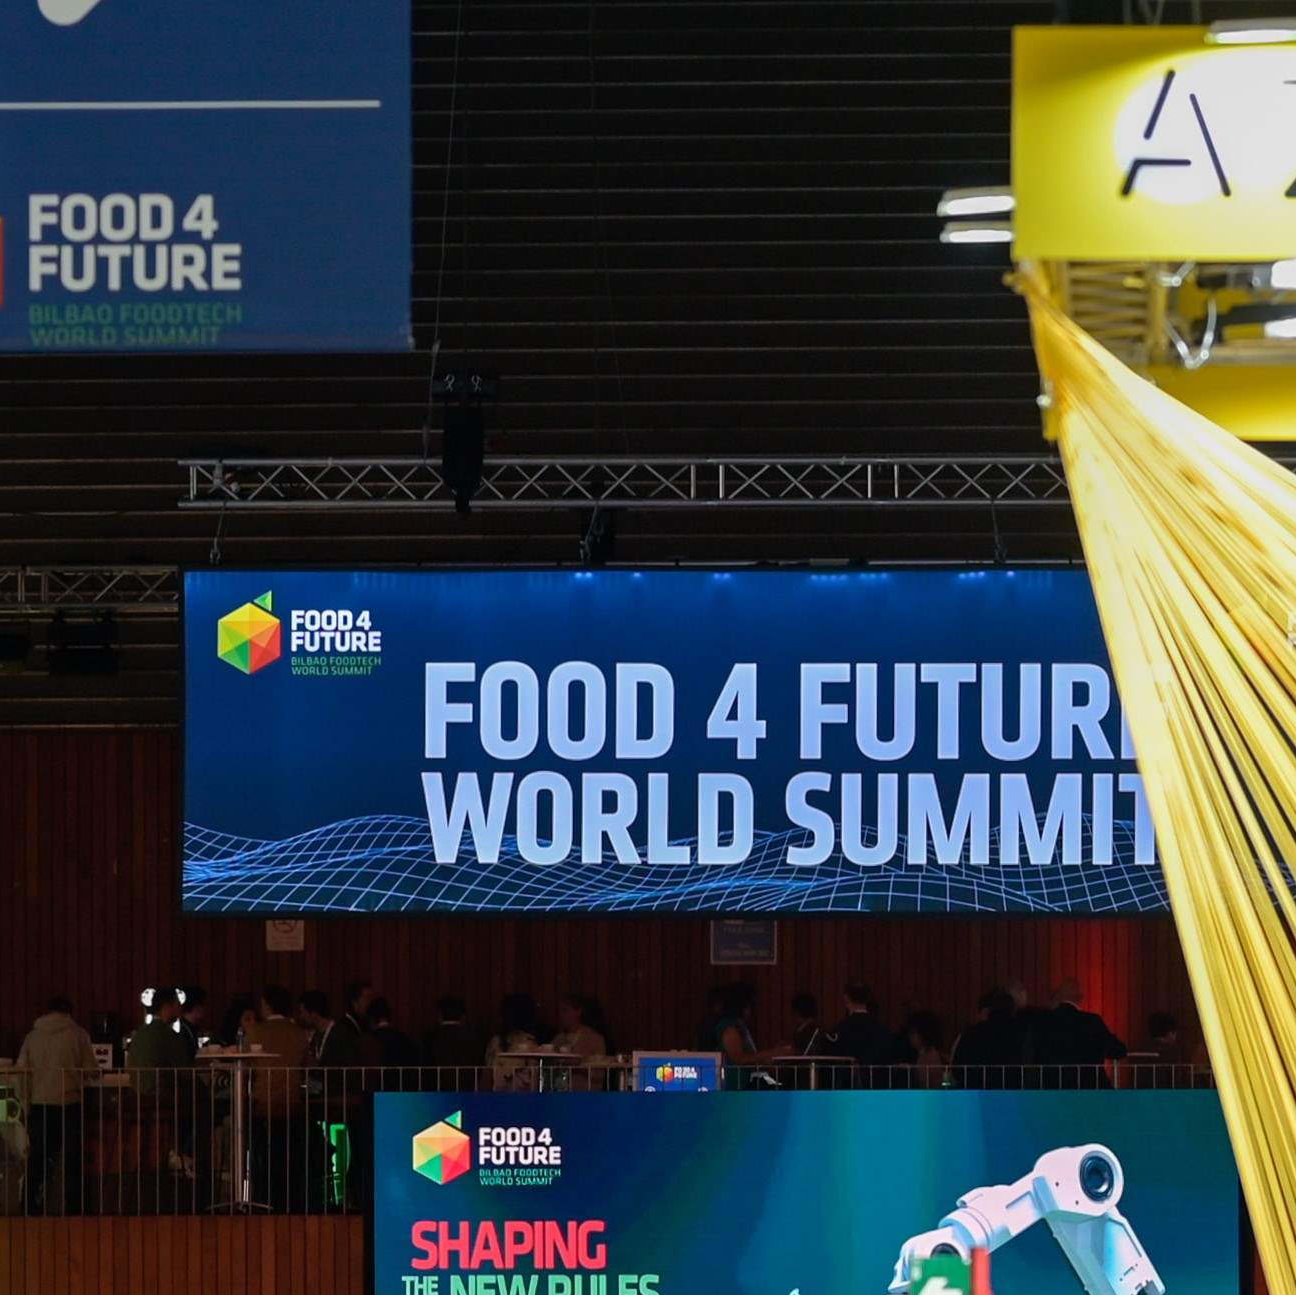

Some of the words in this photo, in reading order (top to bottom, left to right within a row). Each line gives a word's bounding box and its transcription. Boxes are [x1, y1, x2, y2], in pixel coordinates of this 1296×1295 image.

[28, 193, 175, 242] FOOD
[182, 194, 220, 241] 4
[28, 243, 243, 292] FUTURE
[30, 303, 113, 325] BILBAO
[120, 302, 244, 325] FOODTECH
[30, 326, 117, 347] WORLD
[122, 325, 221, 346] SUMMIT
[290, 610, 353, 631] FOOD
[355, 610, 372, 630] 4
[290, 631, 382, 652] FUTURE
[291, 656, 327, 666] BILBAO
[330, 656, 382, 666] FOODTECH
[291, 666, 328, 676] WORLD
[330, 666, 373, 676] SUMMIT
[424, 660, 674, 762] FOOD
[706, 662, 767, 760] 4
[421, 771, 755, 866] WORLD
[785, 771, 1156, 867] SUMMIT
[478, 1127, 536, 1146] FOOD
[537, 1128, 552, 1146] 4
[478, 1146, 562, 1165] FUTURE
[479, 1168, 512, 1177] BILBAO
[513, 1168, 561, 1177] FOODTECH
[480, 1177, 514, 1186] WORLD
[515, 1177, 553, 1186] SUMMIT
[411, 1220, 607, 1270] SHAPING
